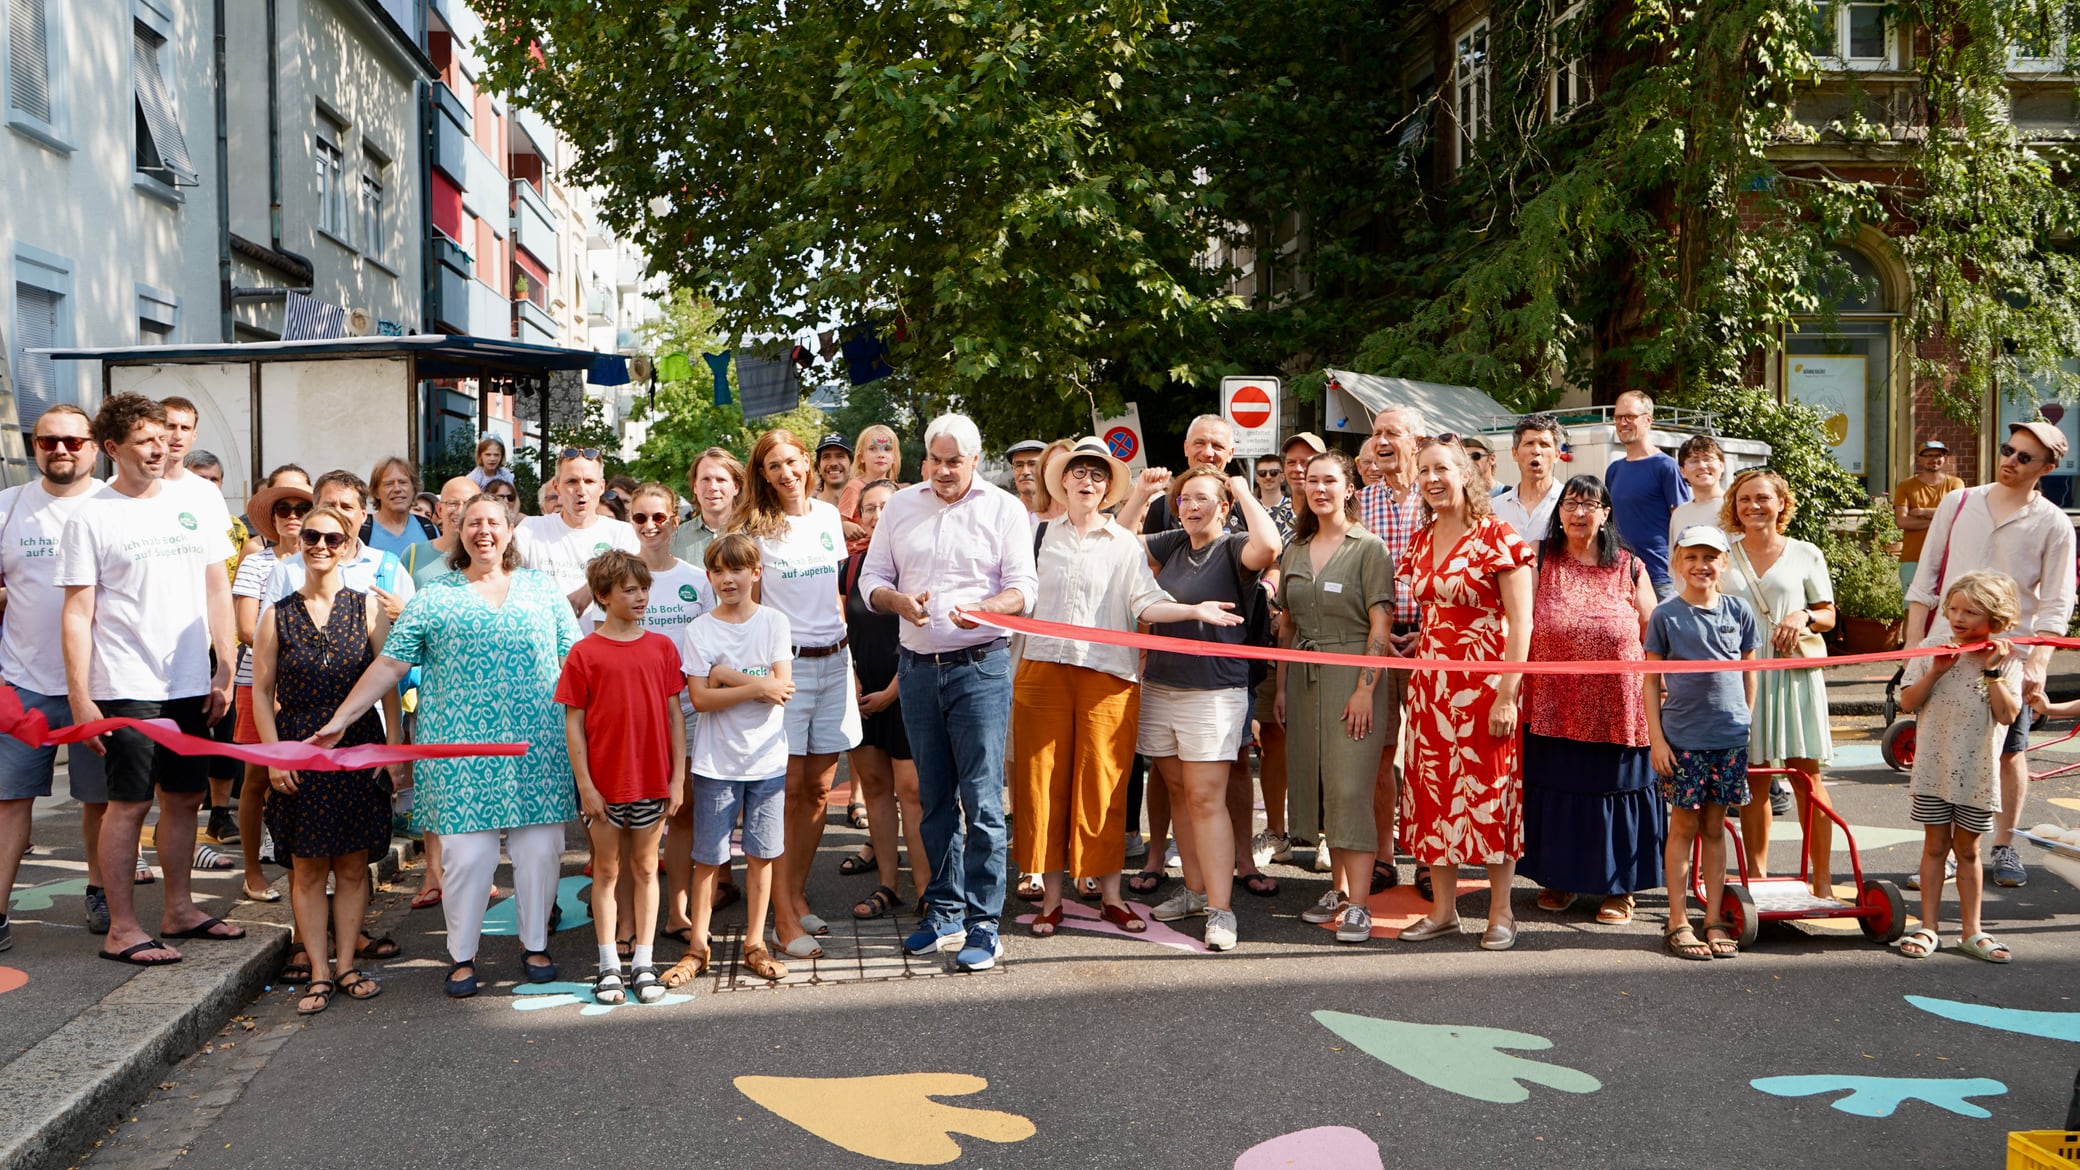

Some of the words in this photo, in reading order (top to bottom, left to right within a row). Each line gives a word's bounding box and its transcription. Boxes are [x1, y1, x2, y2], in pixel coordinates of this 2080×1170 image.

[20, 537, 36, 546] Ich
[39, 537, 59, 545] hab
[123, 541, 140, 551] Ich
[141, 536, 161, 546] hab
[26, 547, 45, 557] auf
[134, 549, 151, 560] auf
[782, 568, 797, 579] auf
[660, 603, 684, 614] Bock
